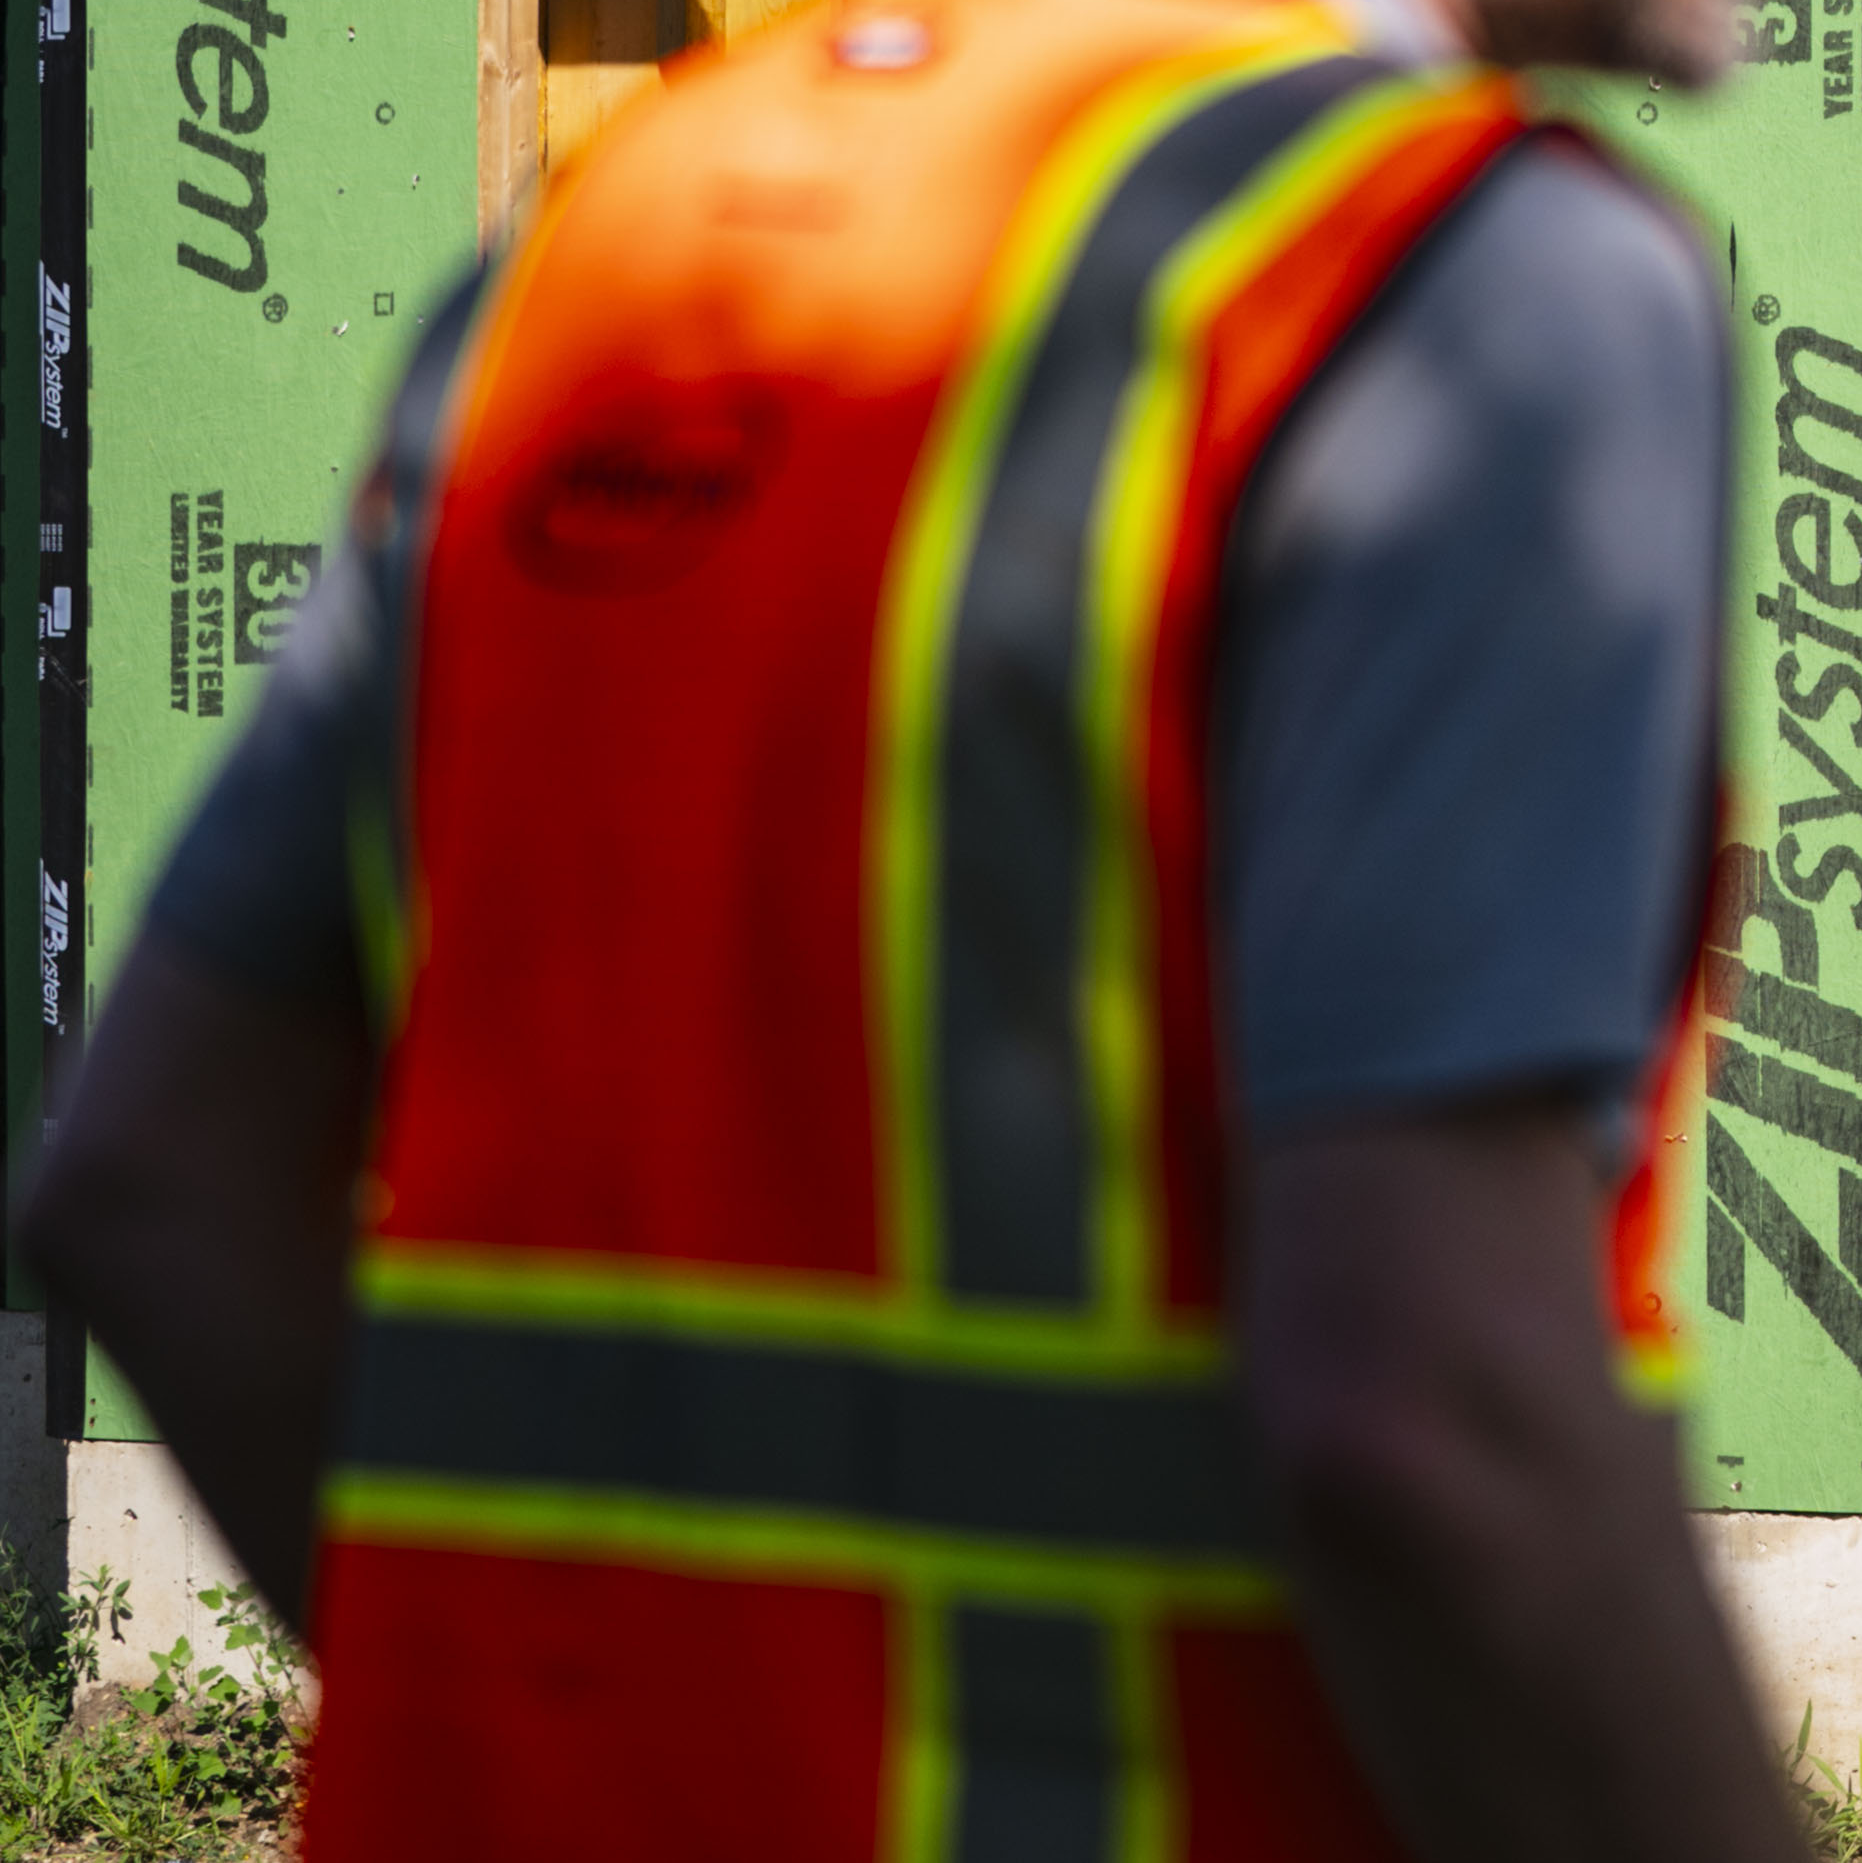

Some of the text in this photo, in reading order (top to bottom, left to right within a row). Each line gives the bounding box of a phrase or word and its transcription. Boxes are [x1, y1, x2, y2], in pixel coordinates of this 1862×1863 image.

[1824, 30, 1853, 119] YEAR
[197, 490, 224, 717] YEAR SYSTEM
